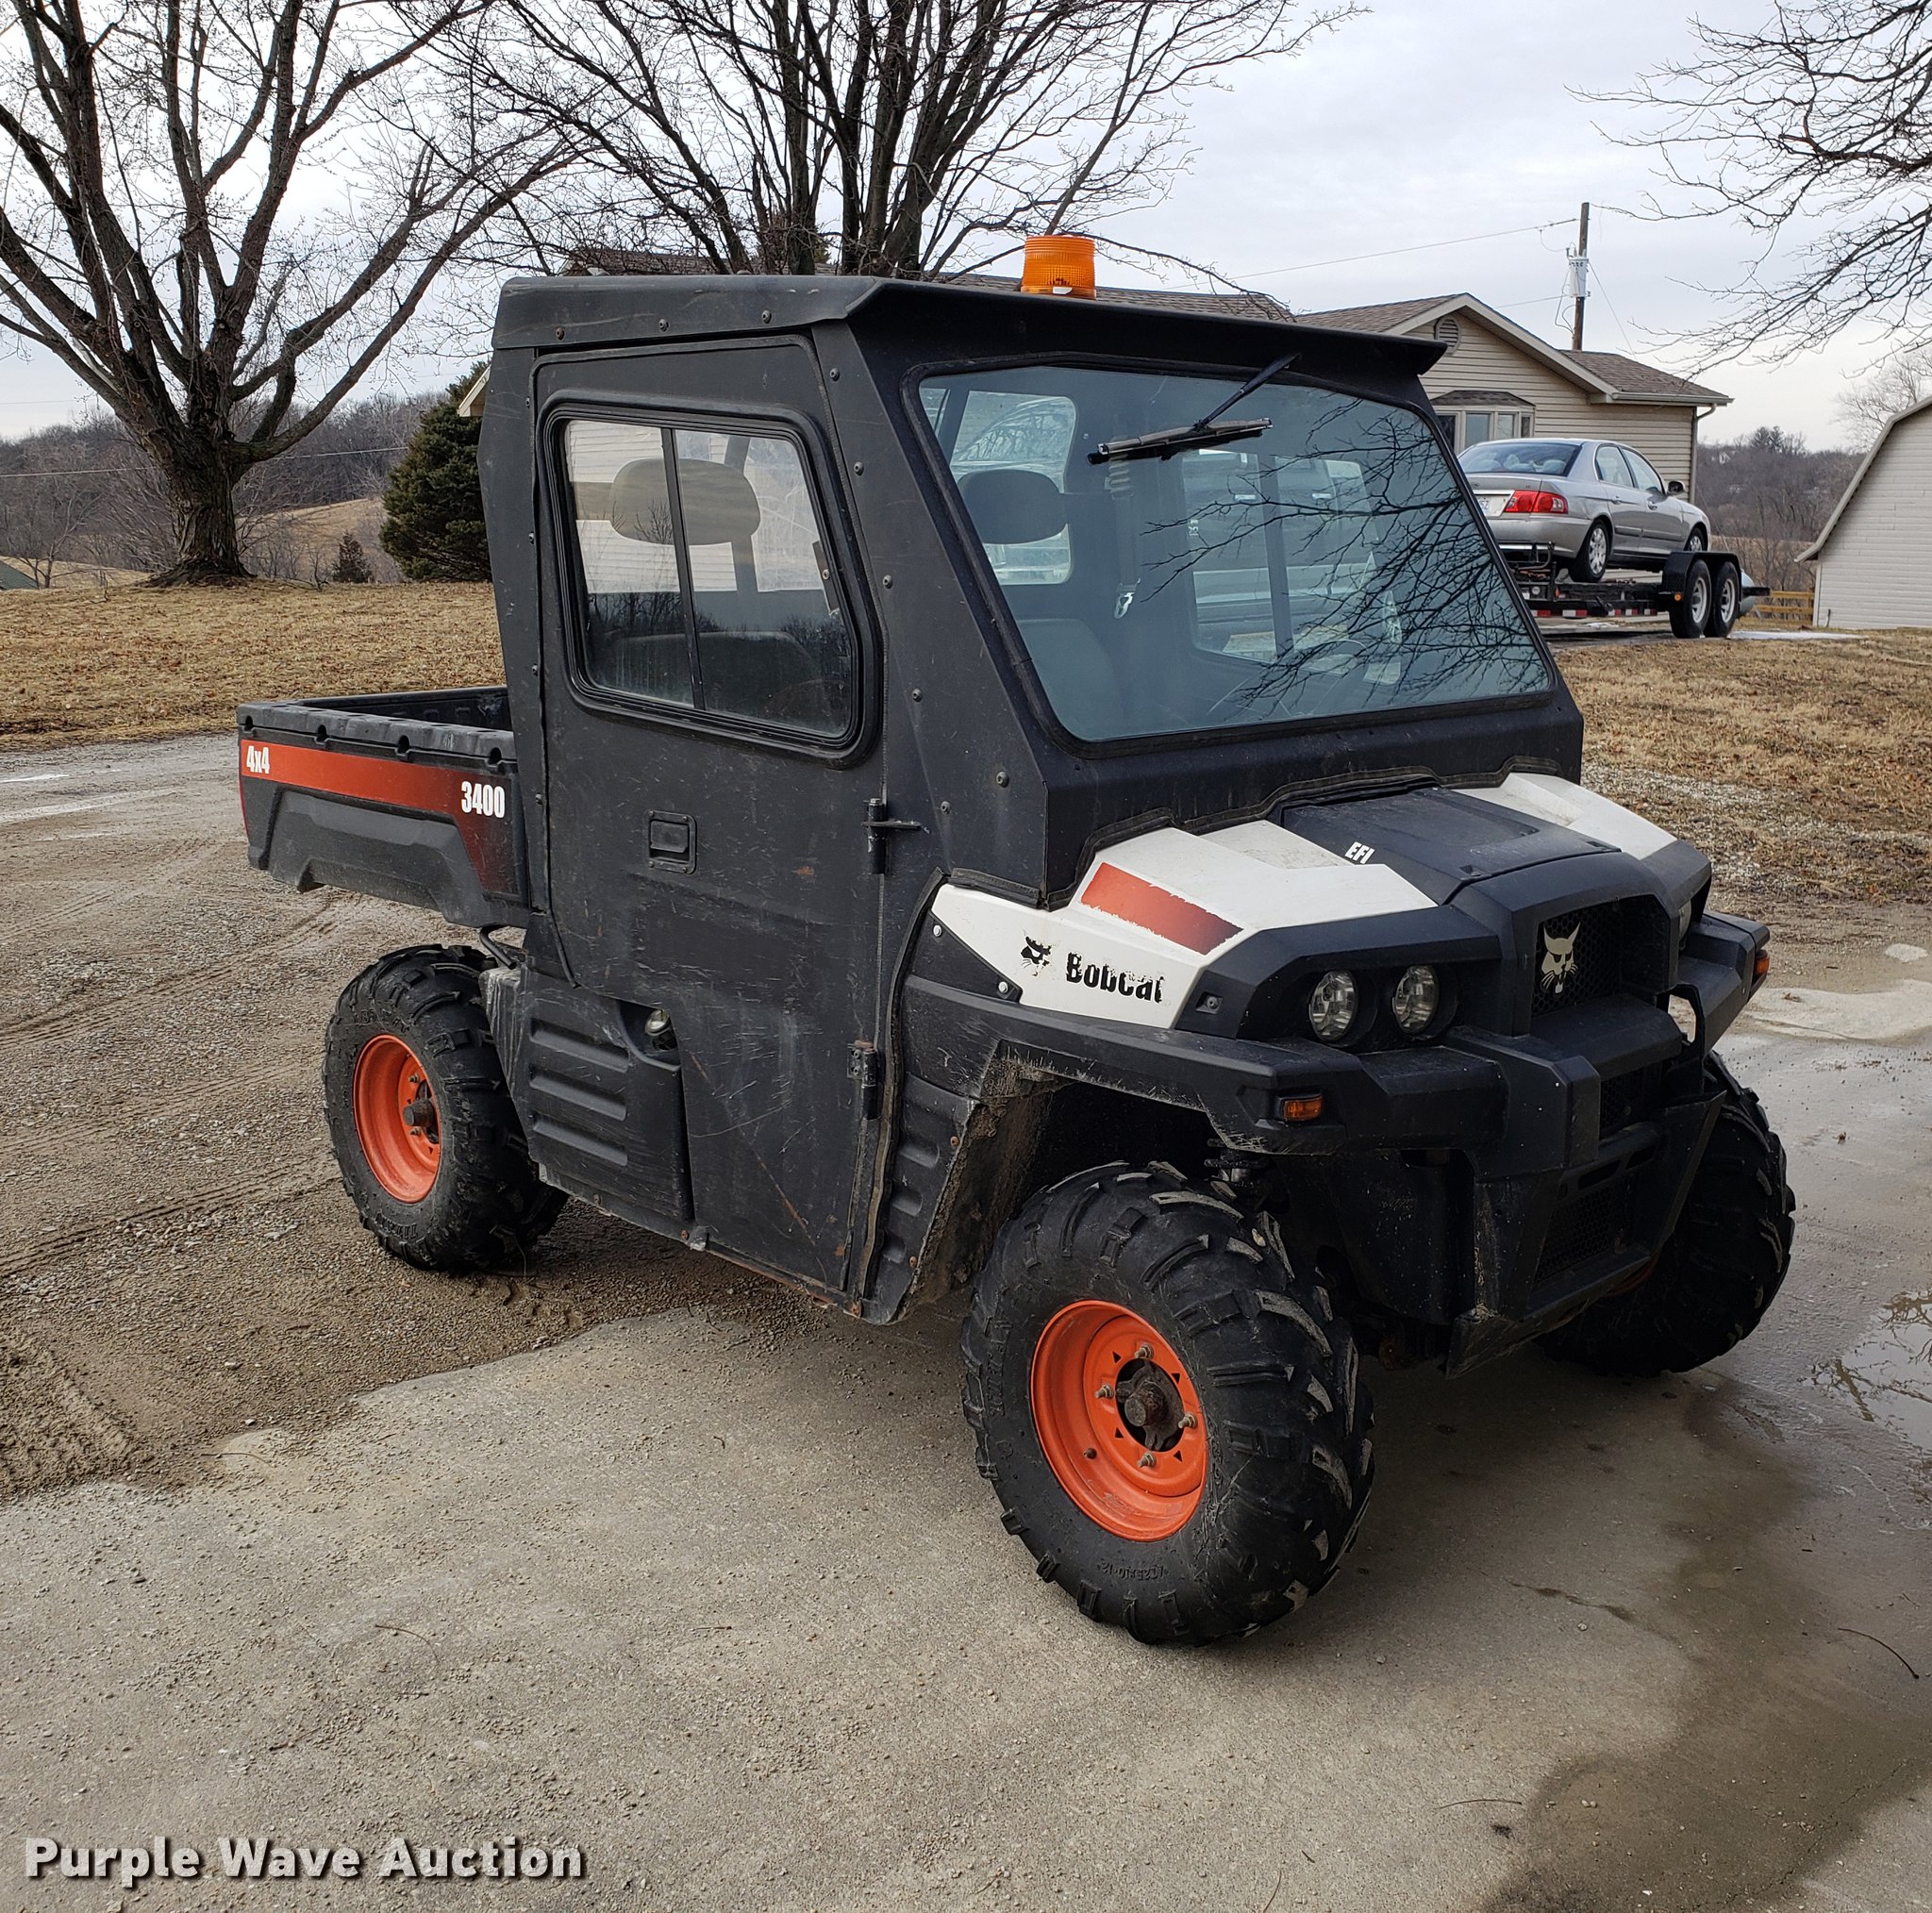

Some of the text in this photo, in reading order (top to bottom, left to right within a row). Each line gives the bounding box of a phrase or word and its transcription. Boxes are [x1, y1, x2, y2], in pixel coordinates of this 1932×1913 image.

[246, 745, 270, 774] 4x4
[460, 781, 506, 819] 3400
[1344, 840, 1375, 865] EFI
[1066, 951, 1165, 1004] Bobcat
